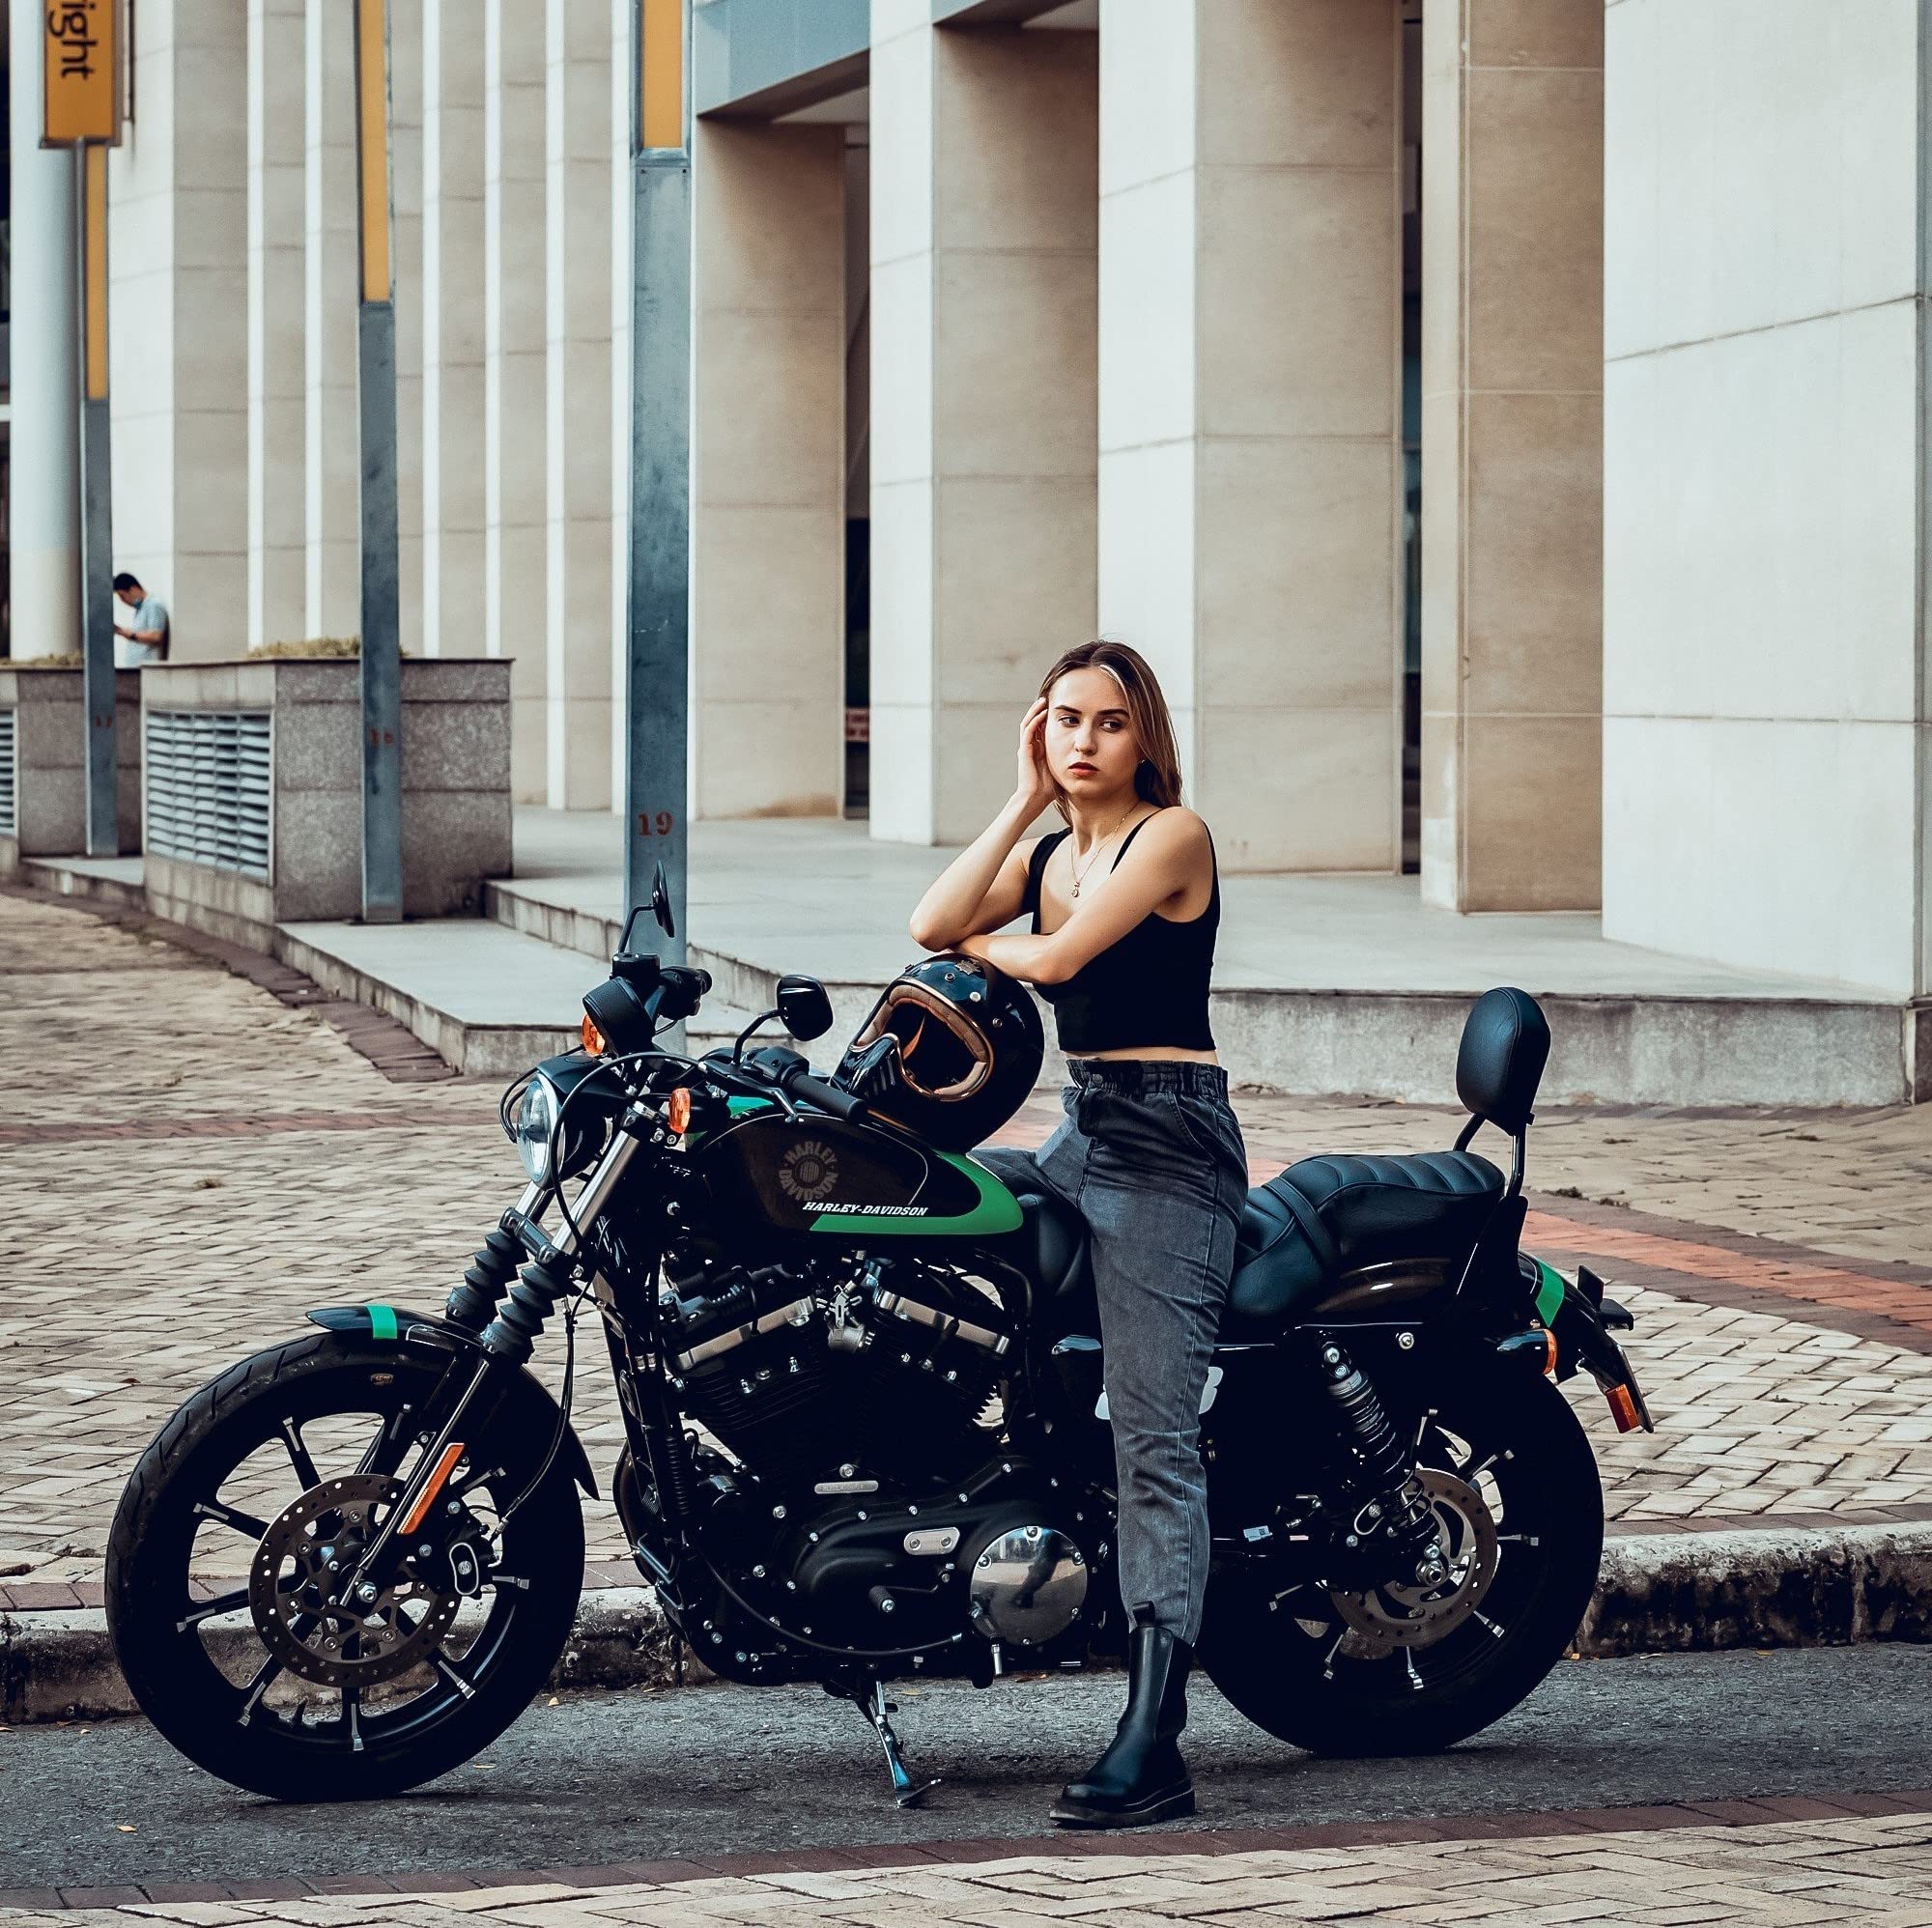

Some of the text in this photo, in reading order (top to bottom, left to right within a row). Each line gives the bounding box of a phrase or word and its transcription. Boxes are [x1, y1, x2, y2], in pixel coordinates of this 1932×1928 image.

[49, 0, 97, 80] ight
[638, 811, 673, 836] 19
[783, 1141, 838, 1165] HARLEY
[779, 1169, 838, 1201] DAVIDSON
[803, 1202, 928, 1216] HARLEY-DAVIDSON
